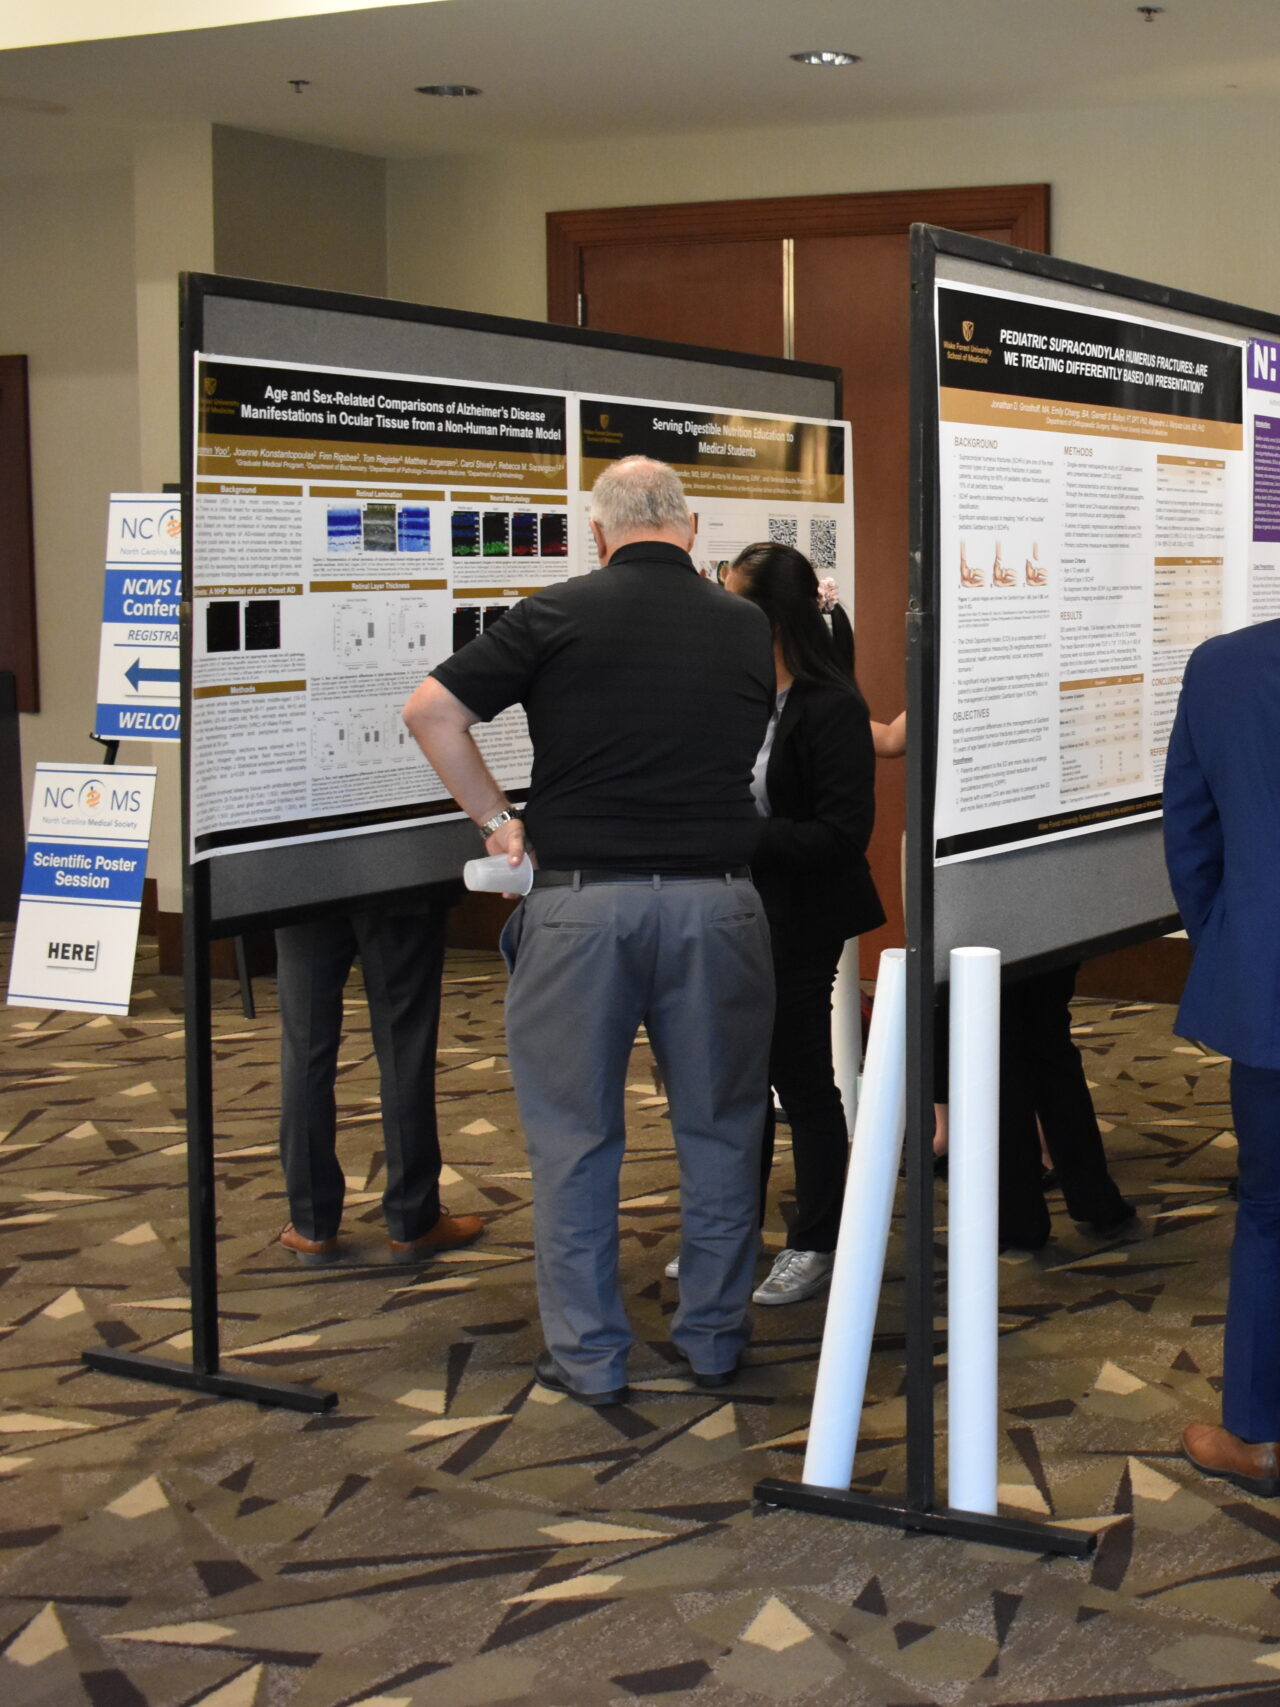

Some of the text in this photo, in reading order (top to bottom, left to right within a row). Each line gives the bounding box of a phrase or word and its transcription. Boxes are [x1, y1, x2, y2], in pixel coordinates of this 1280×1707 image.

[947, 351, 962, 360] School
[1000, 329, 1208, 377] PEDIATRIC SUPRACONDYLAR HUMERUS FRACTURES: ARE
[1004, 351, 1205, 394] WE TREATING DIFFERENTLY BASED ON PRESENTATION?
[264, 385, 546, 422] Age and Sex-Related Comparisons of Alzheimer's Disease
[241, 404, 324, 424] Manifestations
[326, 411, 337, 425] in
[339, 412, 374, 428] Ocular
[376, 414, 410, 430] Tissue
[412, 417, 435, 431] from
[437, 423, 443, 432] a
[445, 421, 498, 436] Non-Human
[499, 426, 533, 439] Primate
[535, 427, 562, 440] Model
[652, 418, 794, 443] Serving Digestible Nutrition Education to
[698, 441, 756, 458] Medical Students
[954, 436, 998, 449] BACKGROUND
[1064, 446, 1093, 457] METHODS
[220, 485, 257, 495] Background
[121, 518, 154, 540] NC
[120, 548, 139, 556] North
[140, 549, 168, 557] Carolina
[122, 578, 172, 596] NCMS
[228, 586, 246, 595] Model
[254, 586, 267, 594] Late
[1060, 611, 1083, 621] RESULTS
[128, 629, 180, 641] REGISTRA
[119, 711, 181, 730] WELCO
[953, 708, 990, 721] OBJECTIVES
[44, 787, 141, 812] NC MS
[42, 816, 138, 830] North Carolina Medical Society
[33, 851, 137, 872] Scientific Poster
[54, 870, 110, 889] Session
[47, 941, 96, 962] HERE
